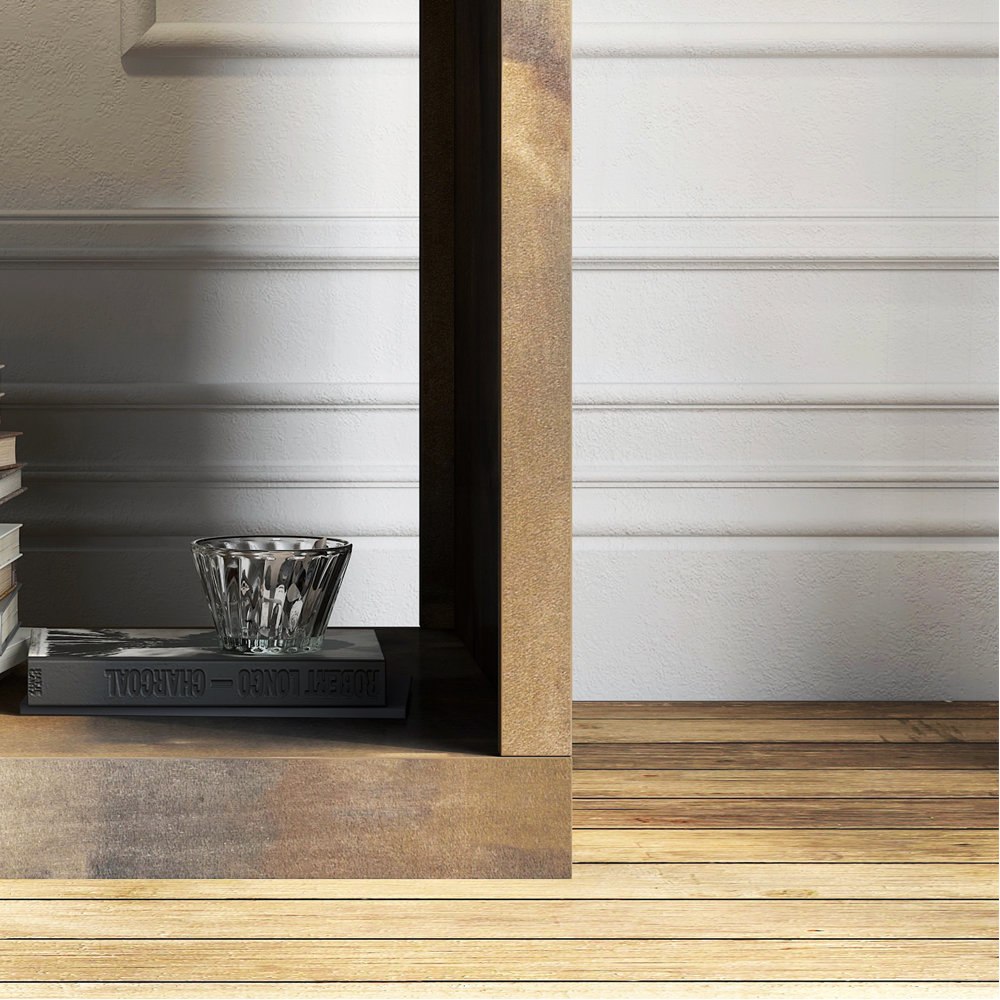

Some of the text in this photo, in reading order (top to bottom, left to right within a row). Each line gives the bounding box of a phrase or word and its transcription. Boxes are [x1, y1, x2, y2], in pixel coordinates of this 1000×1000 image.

[103, 668, 206, 698] CHARCOAL
[236, 668, 300, 698] LONGO
[305, 668, 381, 698] ROBERT
